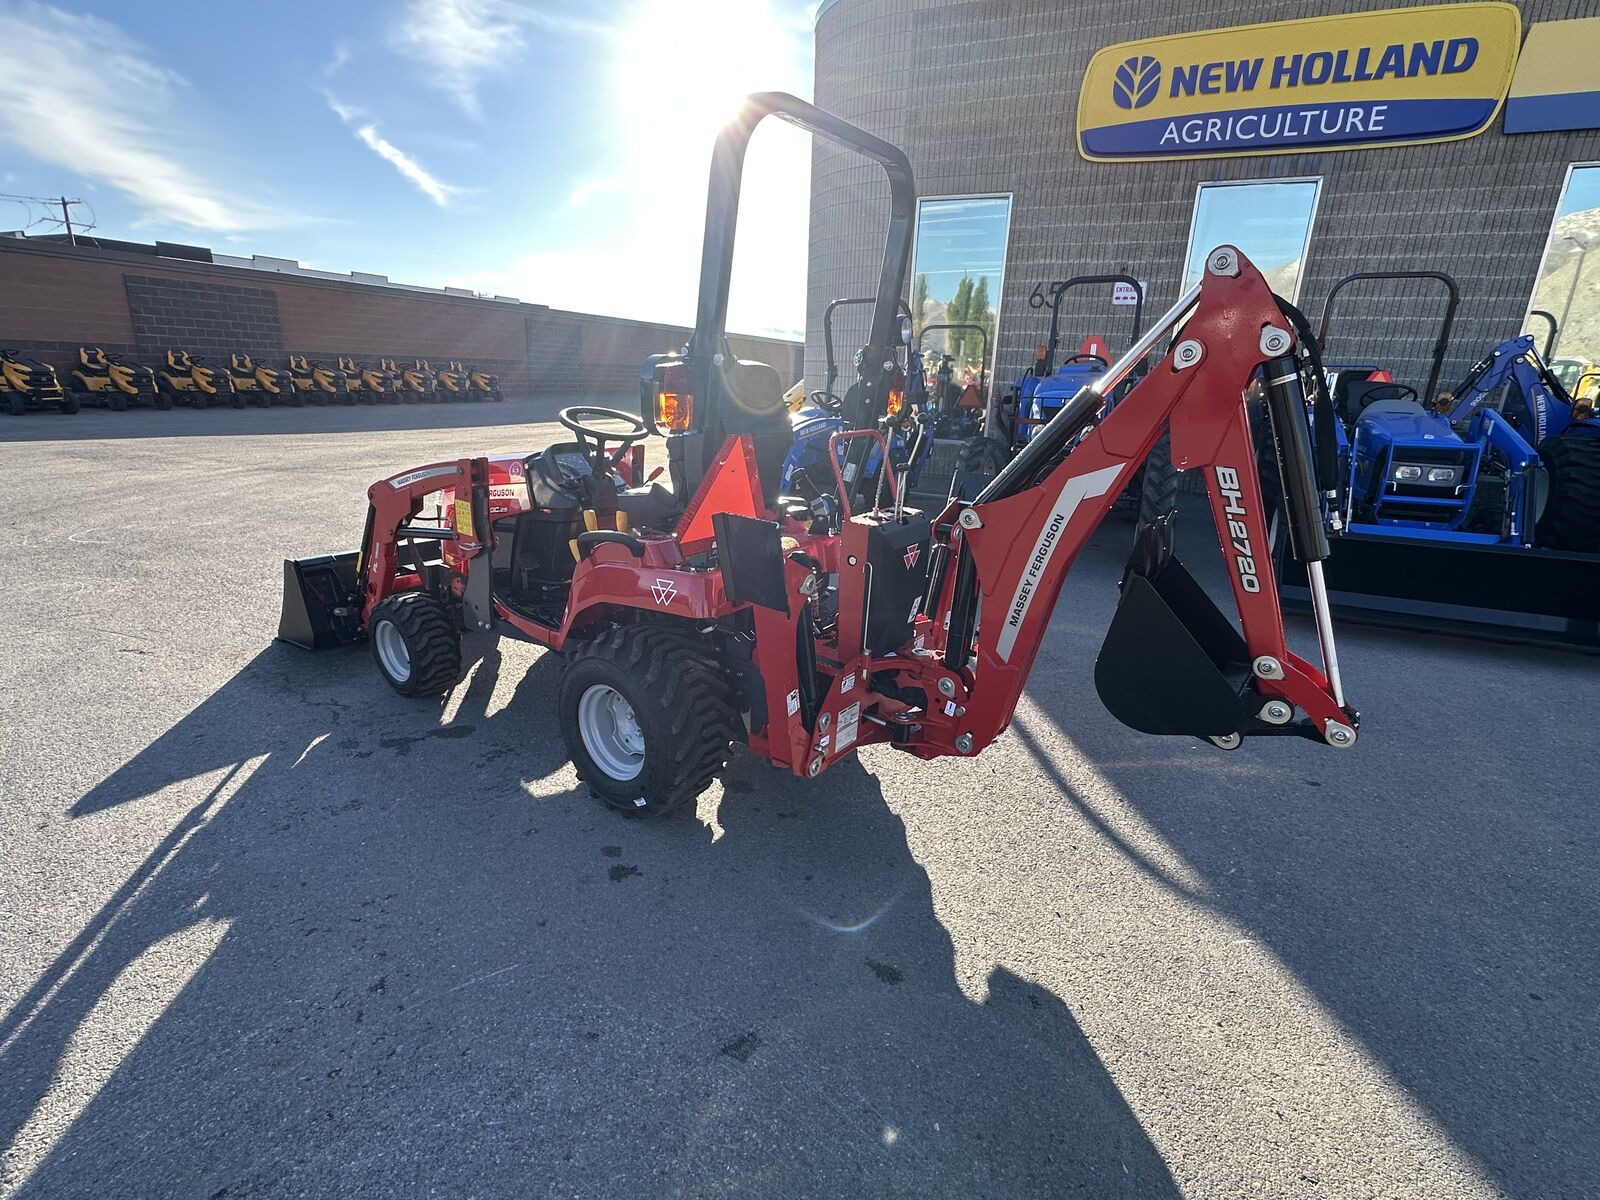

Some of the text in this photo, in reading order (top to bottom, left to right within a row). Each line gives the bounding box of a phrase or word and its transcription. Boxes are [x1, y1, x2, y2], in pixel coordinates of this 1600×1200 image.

[1169, 37, 1480, 98] NEW HOLLAND
[1159, 105, 1388, 145] AGRICULTURE
[1536, 394, 1547, 445] NEW HOLLAN
[489, 489, 515, 497] RGUSON
[1214, 465, 1260, 593] BH.2720
[1009, 513, 1065, 627] MASSEY FERGUSON
